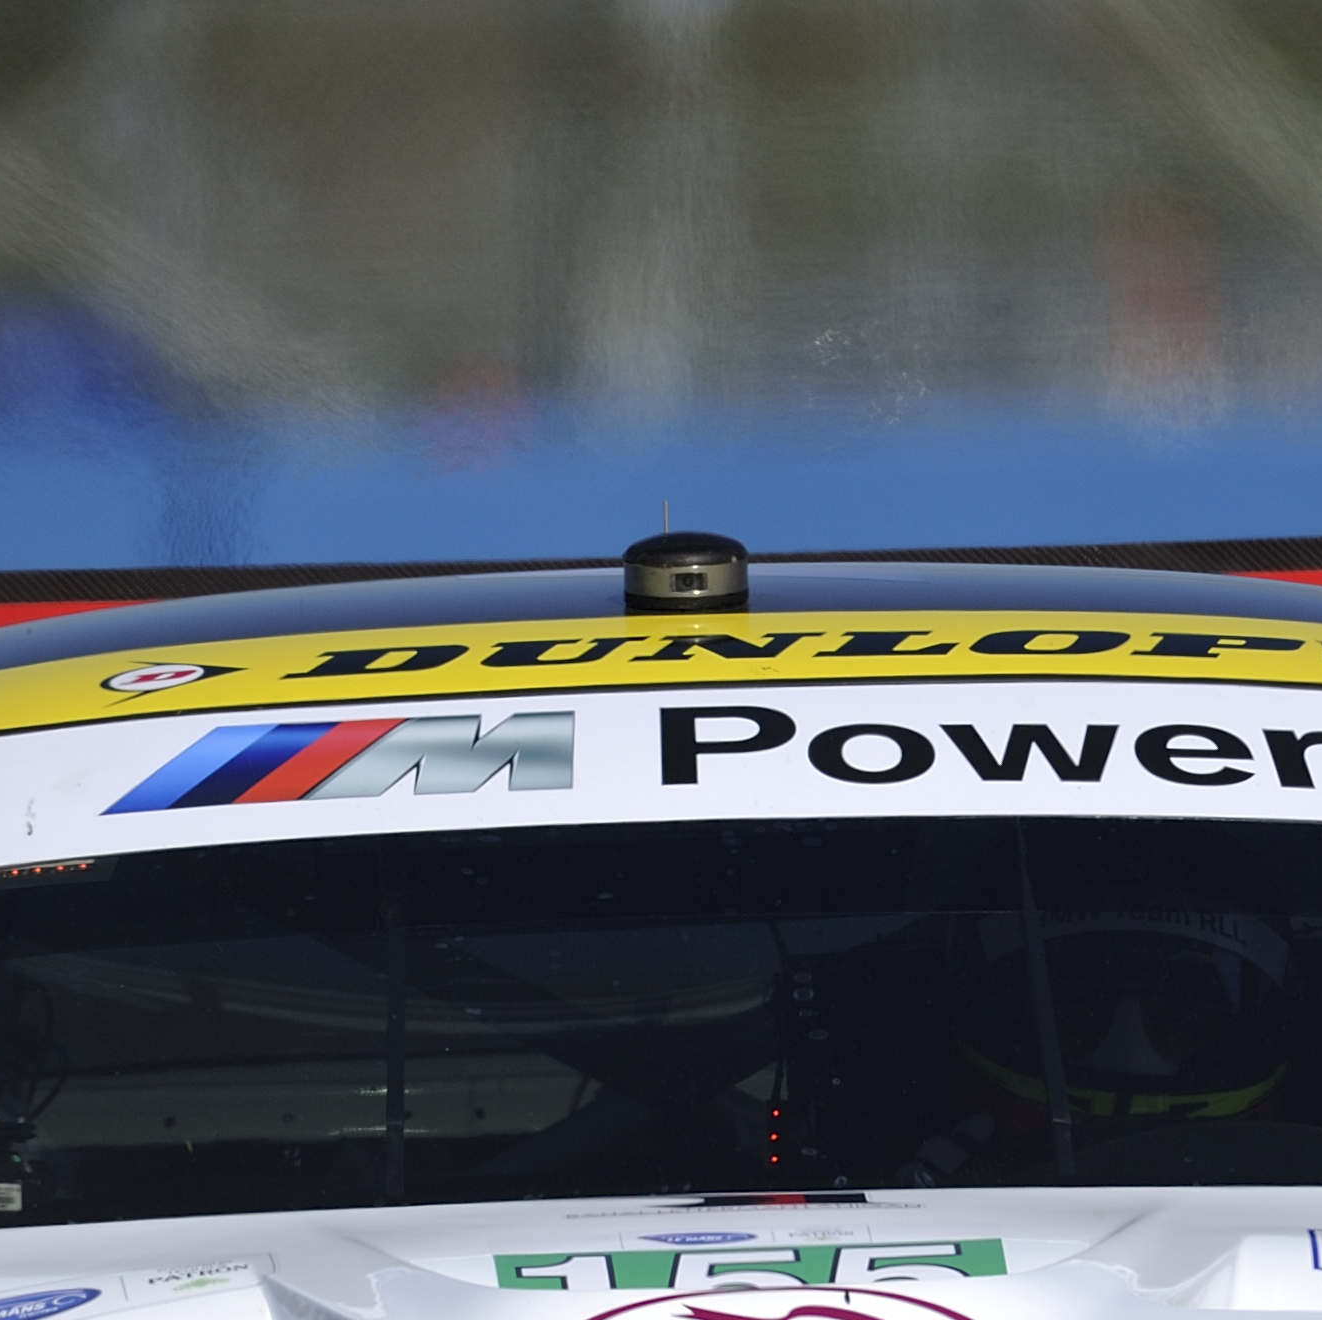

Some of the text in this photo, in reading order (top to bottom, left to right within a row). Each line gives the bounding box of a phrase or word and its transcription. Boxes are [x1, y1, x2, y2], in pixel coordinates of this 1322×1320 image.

[281, 629, 1305, 680] DUNLOP
[1115, 904, 1191, 928] Team
[1200, 912, 1248, 946] RLL
